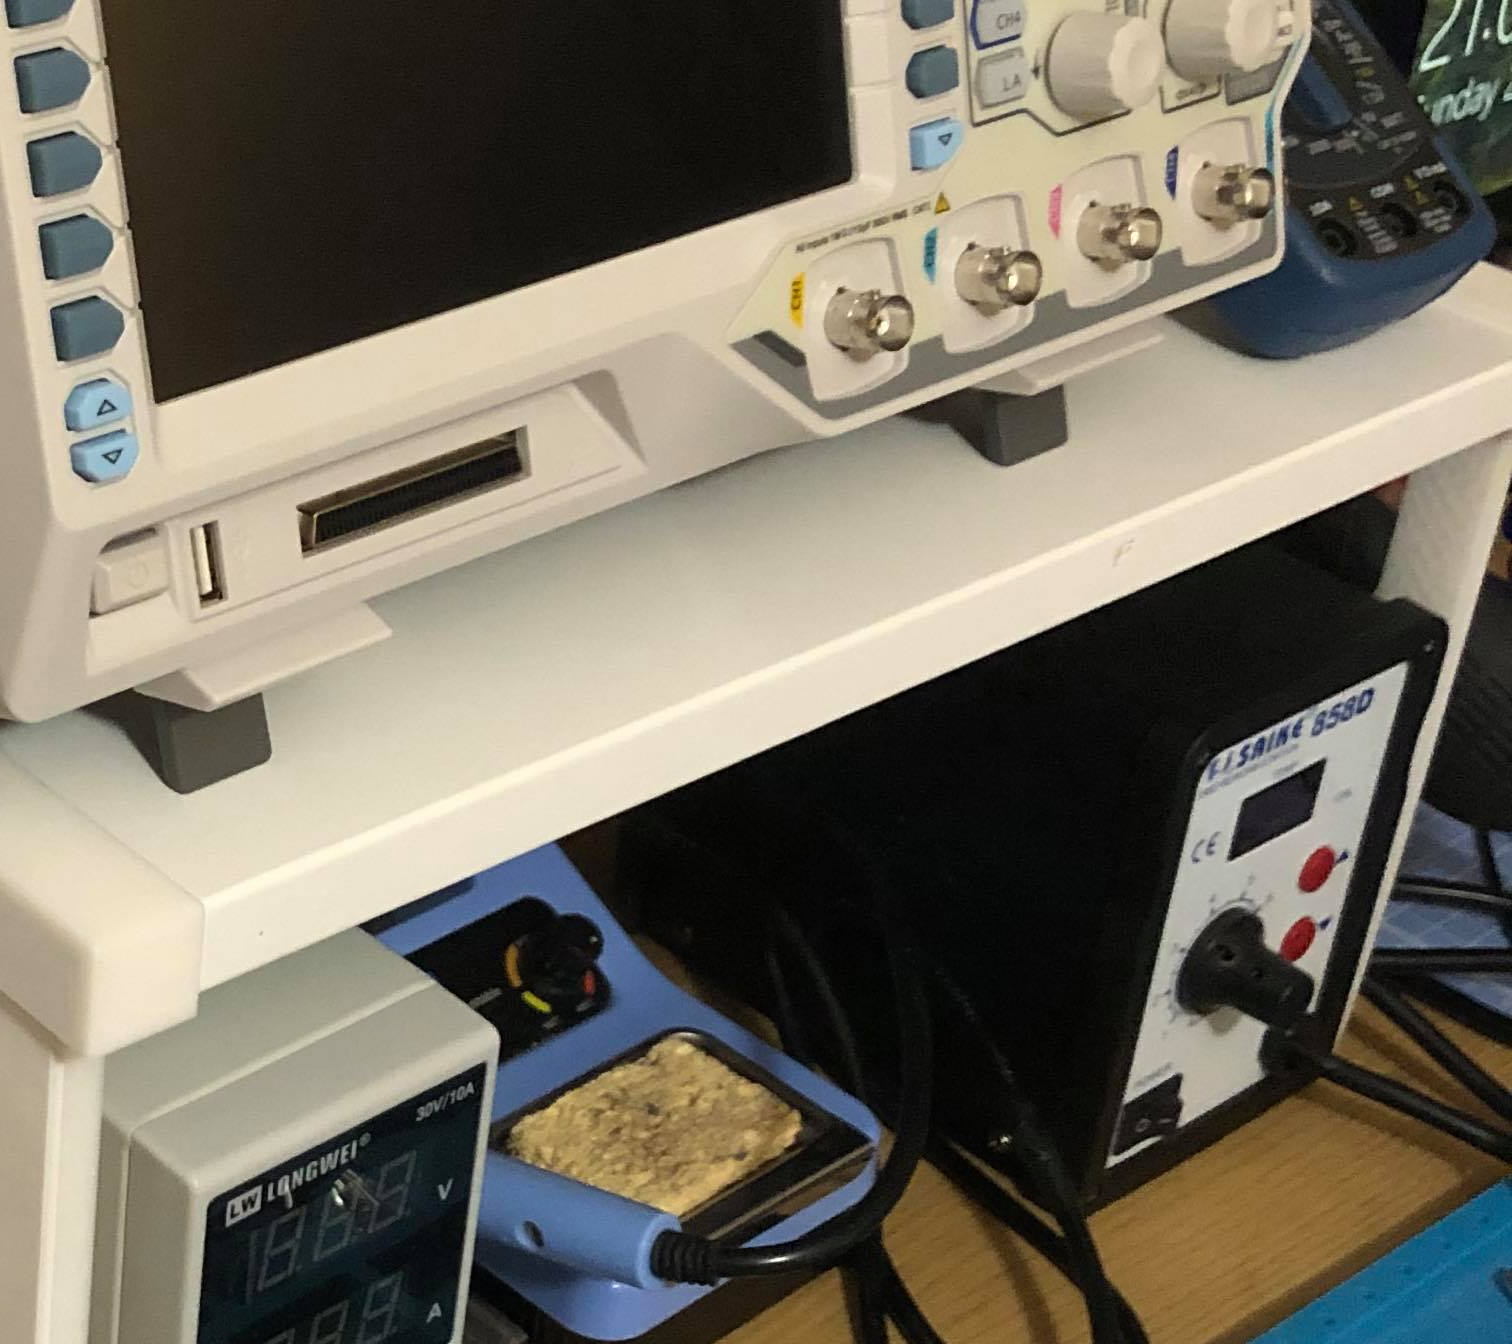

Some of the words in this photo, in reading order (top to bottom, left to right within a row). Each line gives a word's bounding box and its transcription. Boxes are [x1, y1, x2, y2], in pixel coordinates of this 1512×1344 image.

[996, 12, 1022, 32] CH4
[1003, 73, 1022, 92] LA
[1310, 686, 1376, 738] 858D
[414, 1081, 476, 1123] 30V/10A
[229, 1187, 261, 1222] LW
[265, 1139, 359, 1202] LONGWEI
[437, 1178, 454, 1201] V
[426, 1302, 443, 1325] A
